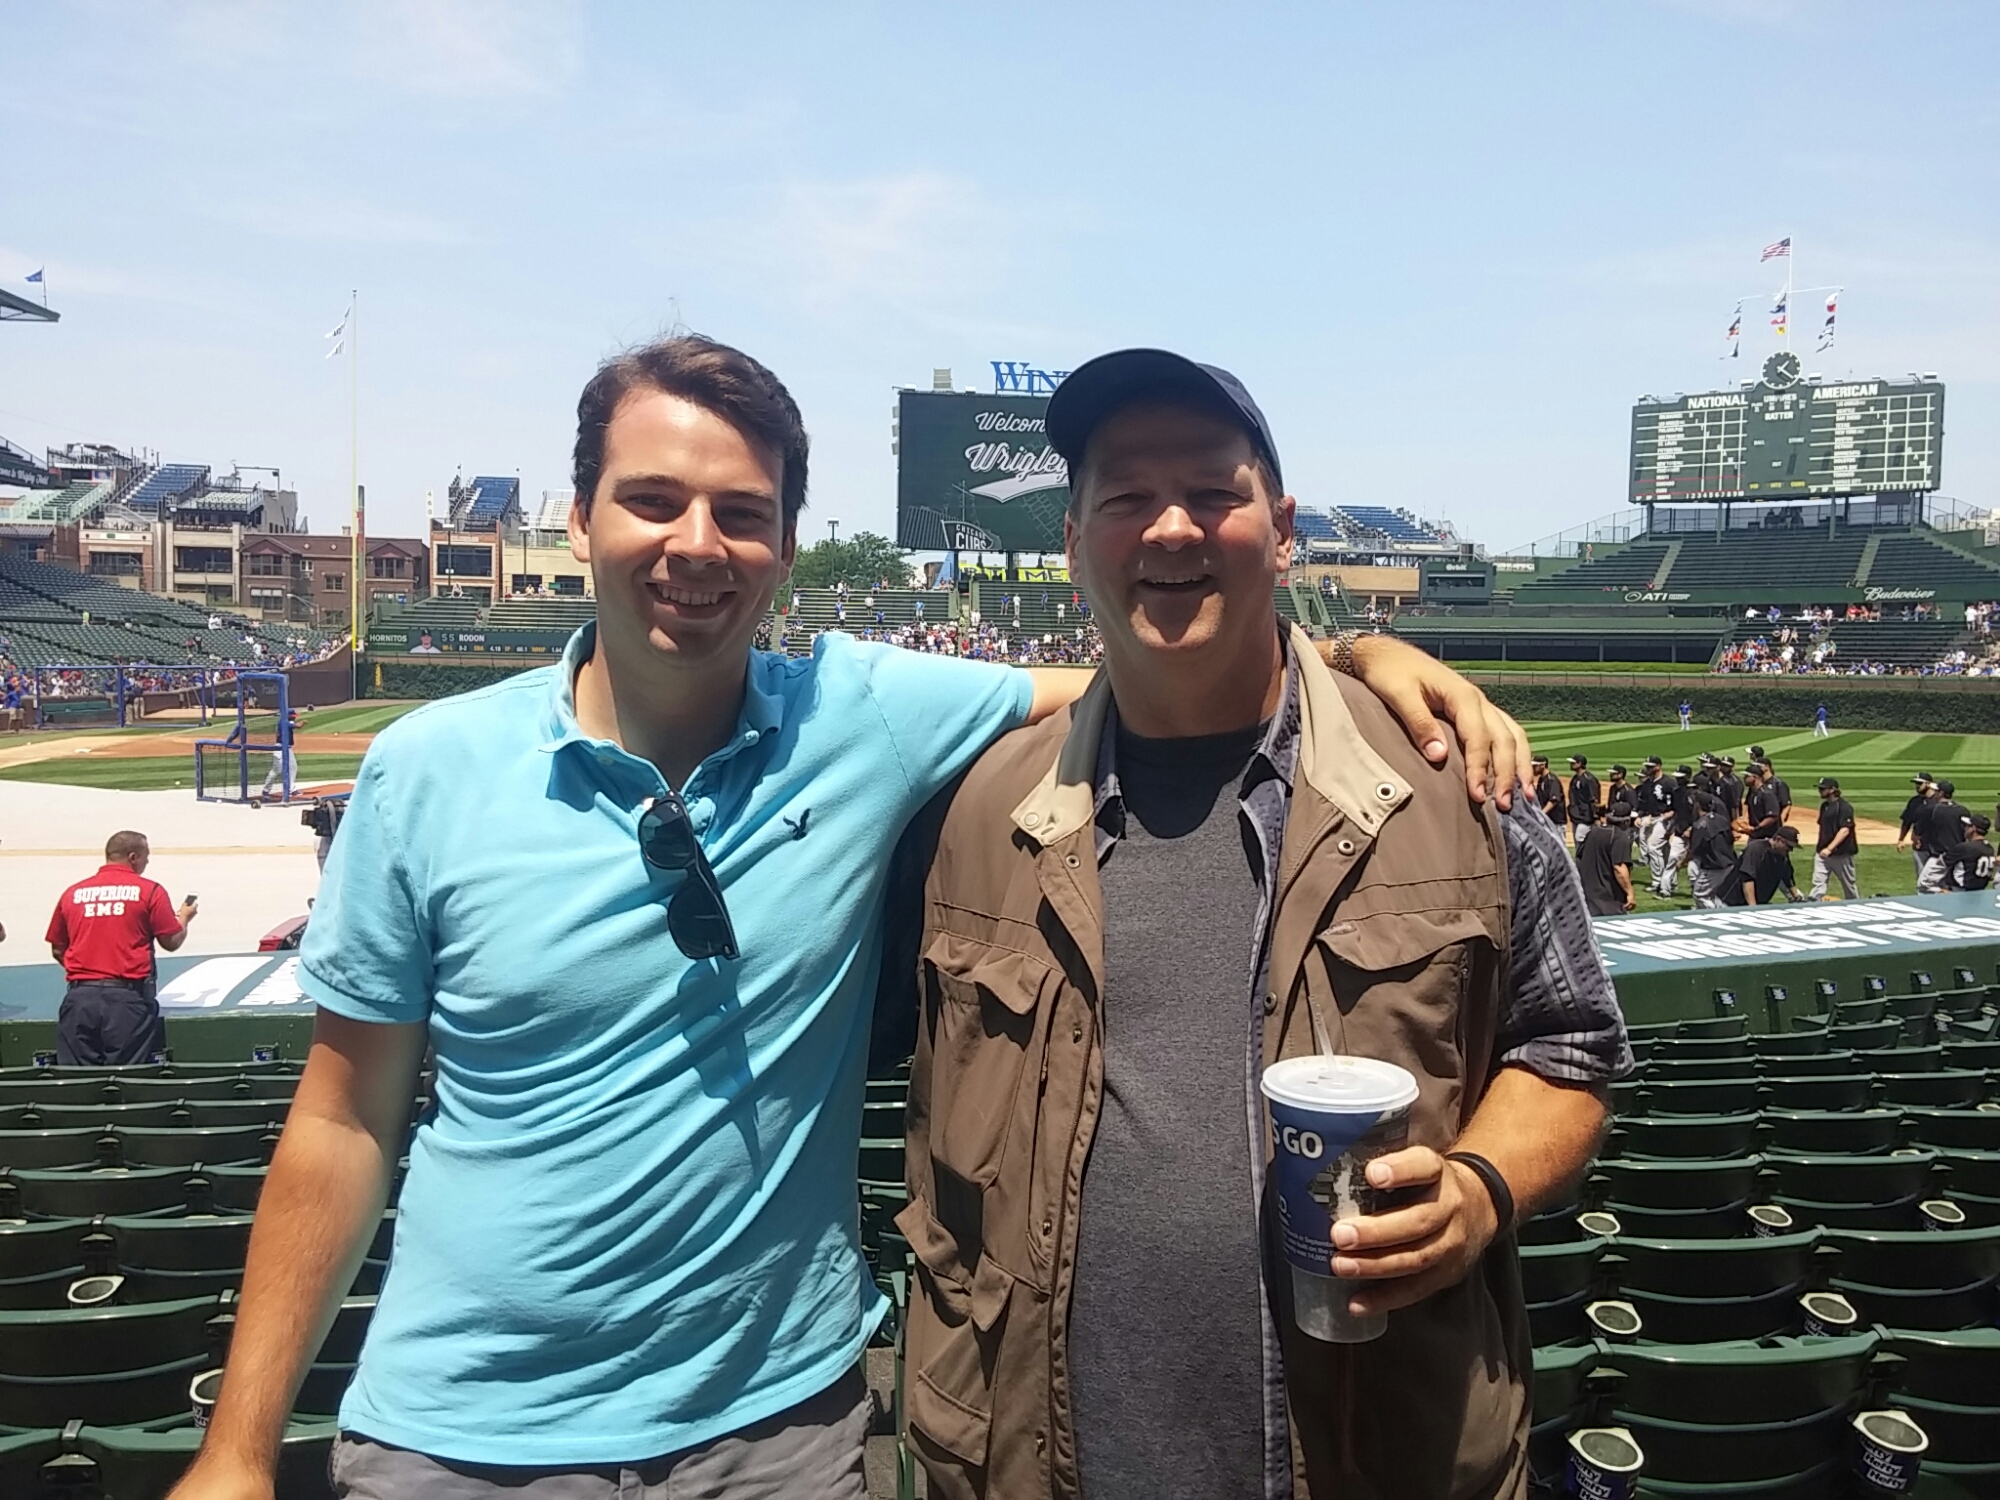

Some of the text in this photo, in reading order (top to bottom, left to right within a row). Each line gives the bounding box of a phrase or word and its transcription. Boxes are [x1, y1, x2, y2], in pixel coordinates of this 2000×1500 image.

[990, 361, 1072, 393] WIN
[1812, 384, 1878, 400] AMERICAN
[1687, 394, 1748, 409] NATIONAL
[1764, 411, 1794, 420] BATTER
[965, 442, 1070, 482] Wrigley
[1445, 563, 1468, 571] Orbit
[1642, 593, 1668, 601] ATI
[1864, 587, 1936, 601] Budweiser
[369, 634, 407, 643] HORNITOS
[459, 634, 485, 642] RODON
[73, 885, 140, 904] SUPERIOR
[84, 902, 125, 917] EMS
[1673, 901, 1944, 931] FRIENDLY
[1600, 927, 1892, 961] WRIGLEY
[1857, 917, 2000, 942] FIELD
[1283, 1126, 1323, 1159] GO
[1865, 1453, 1899, 1476] Hefty
[1577, 1473, 1609, 1496] Hefty
[1869, 1470, 1904, 1489] Hefty
